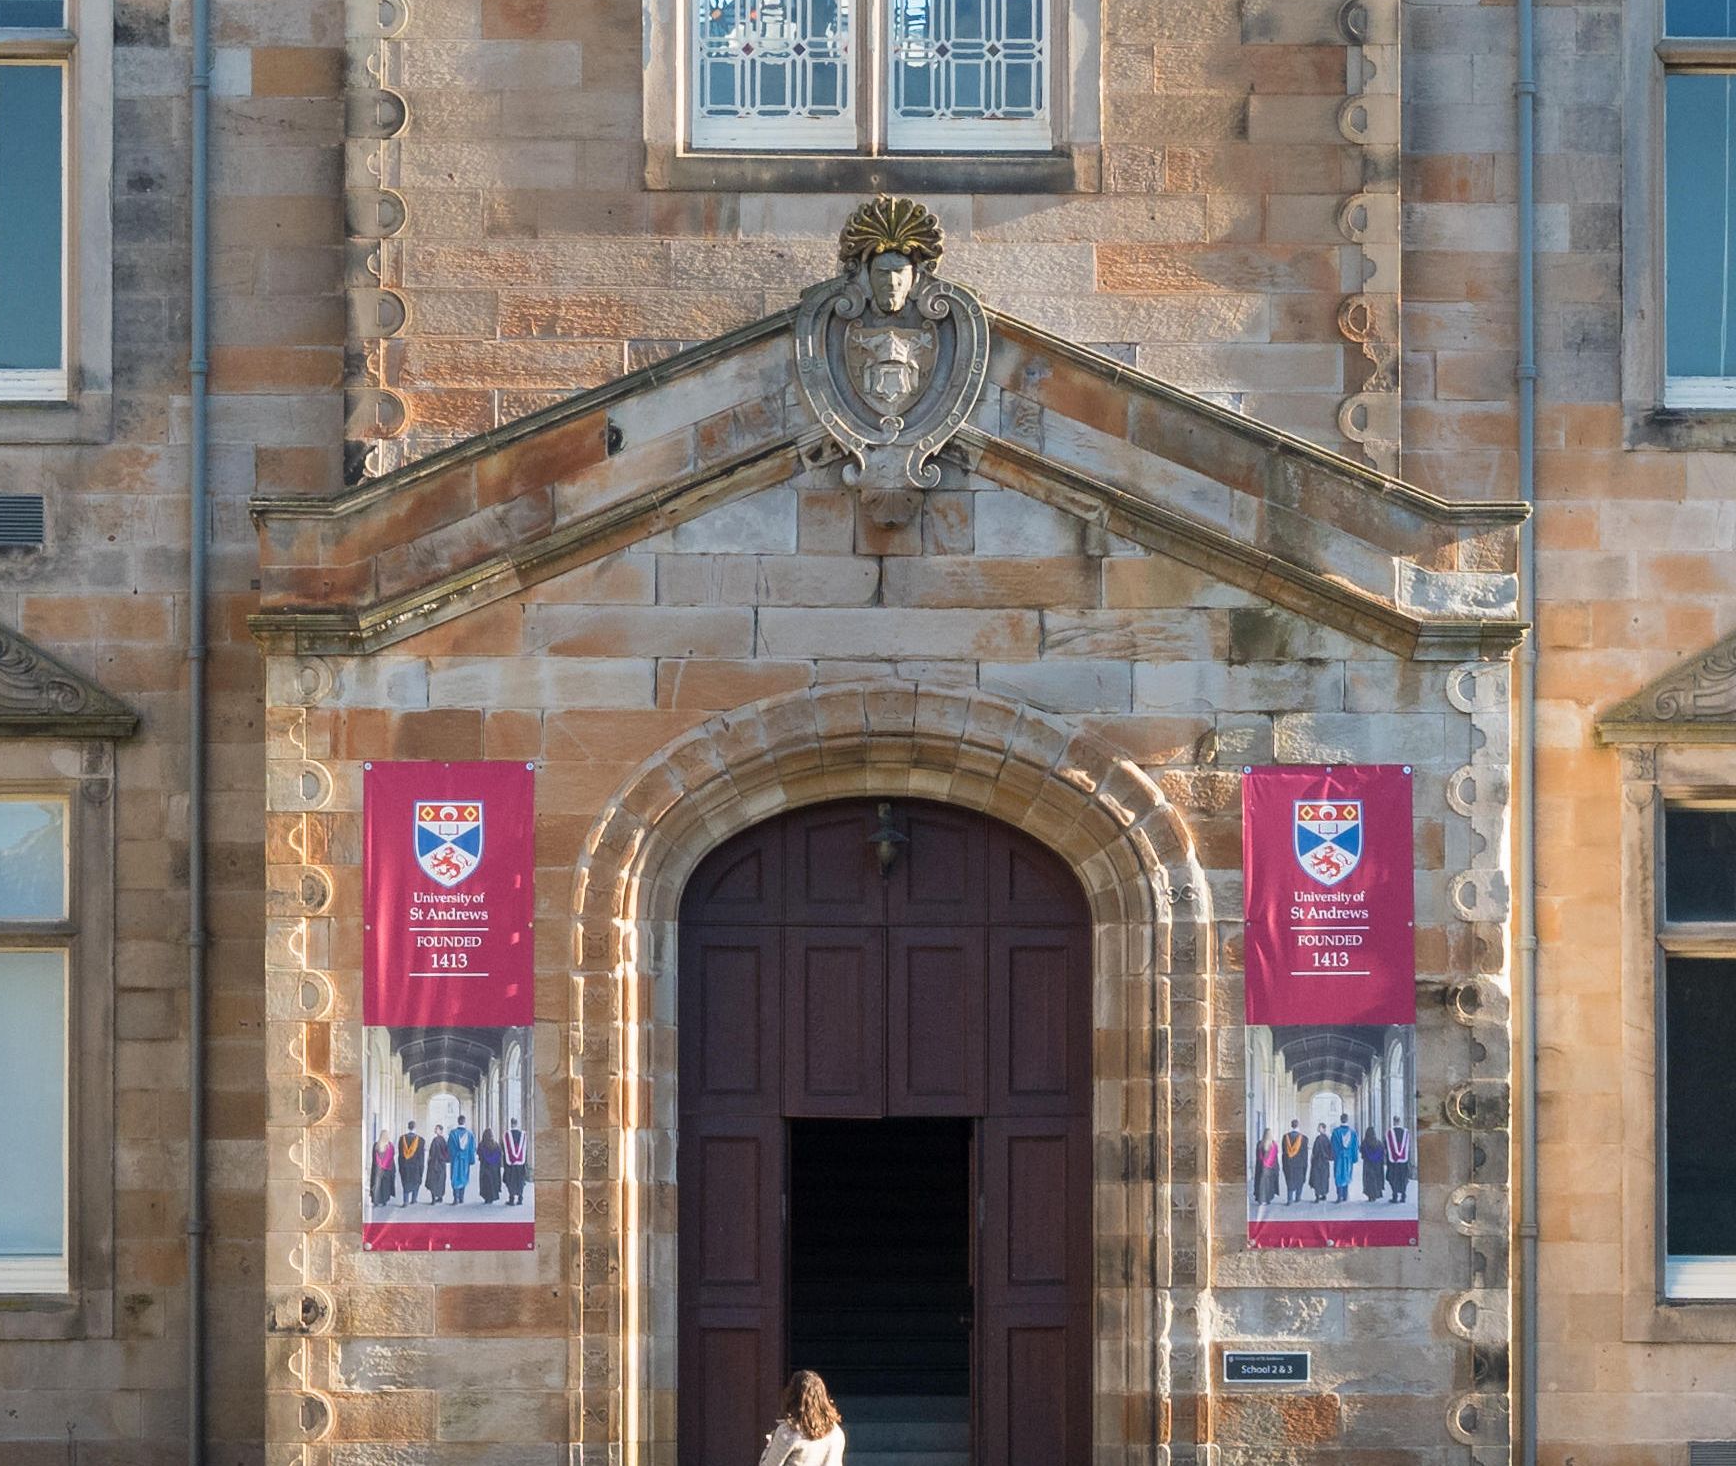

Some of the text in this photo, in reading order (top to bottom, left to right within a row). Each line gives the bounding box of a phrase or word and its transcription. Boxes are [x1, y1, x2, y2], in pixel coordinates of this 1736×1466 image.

[413, 892, 485, 907] University of
[1294, 890, 1366, 905] University of
[409, 907, 489, 921] St Andrews
[1290, 906, 1369, 920] St Andrews
[417, 936, 482, 947] FOUNDED
[1297, 935, 1363, 946] FOUNDED
[431, 953, 468, 968] 1413
[1312, 952, 1349, 967] 1413
[1241, 1365, 1293, 1374] School 2 & 3
